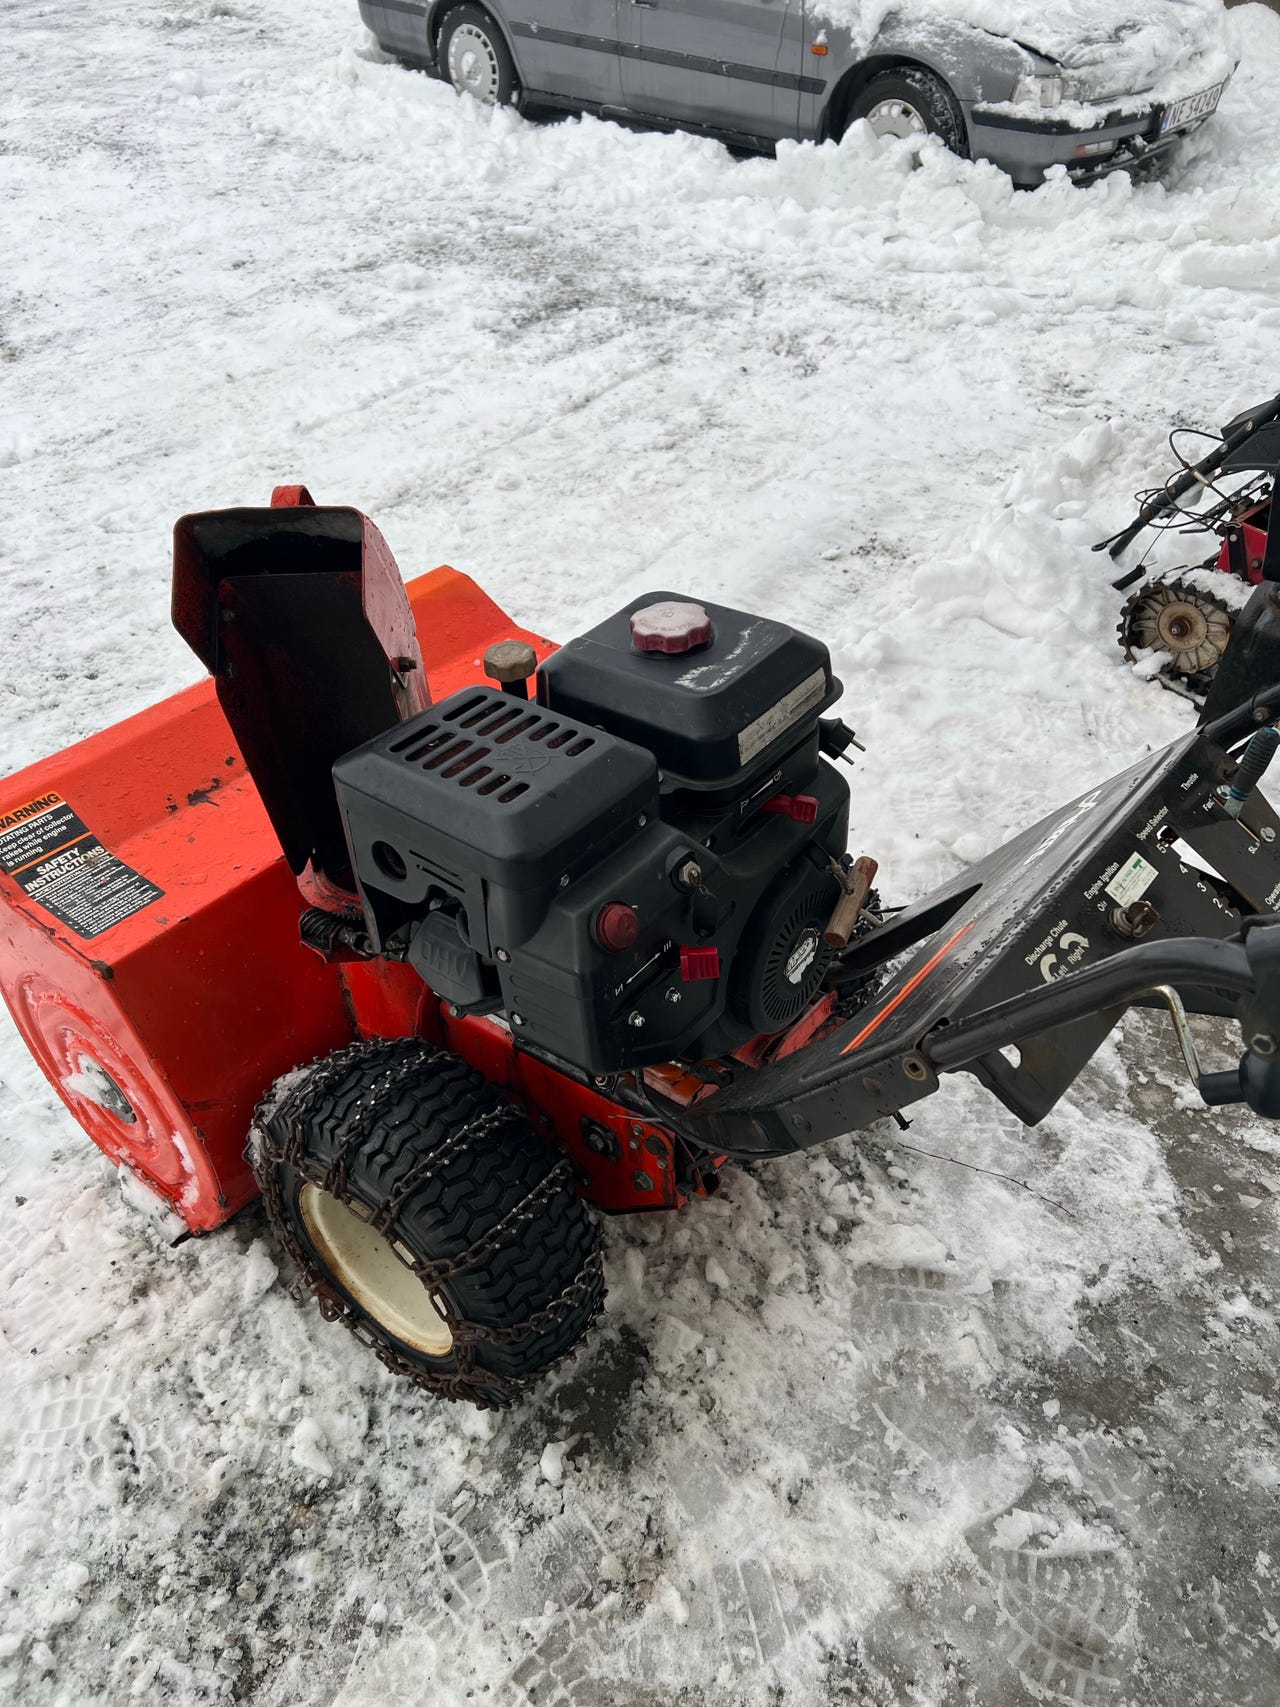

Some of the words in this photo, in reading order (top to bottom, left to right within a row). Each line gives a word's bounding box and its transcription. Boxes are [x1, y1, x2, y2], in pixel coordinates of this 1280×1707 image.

[17, 832, 36, 846] clear
[36, 826, 45, 835] of
[44, 812, 74, 831] collector
[28, 813, 54, 830] PARTS
[1136, 822, 1153, 840] Speed
[1149, 805, 1169, 827] Selector
[22, 837, 43, 851] while
[42, 825, 68, 841] engine
[14, 846, 44, 864] running
[1156, 843, 1167, 854] 5
[24, 845, 105, 893] INSTRUCTIONS
[37, 847, 80, 875] SAFETY
[1179, 863, 1189, 874] 4
[1083, 880, 1104, 900] Engine
[1098, 861, 1120, 883] Ignition
[1196, 882, 1207, 893] 3
[1212, 897, 1223, 909] 2
[1224, 908, 1234, 918] 1
[1024, 935, 1055, 966] Discharge
[1049, 919, 1069, 938] Chute
[1067, 945, 1085, 965] Right
[1053, 964, 1069, 980] Left
